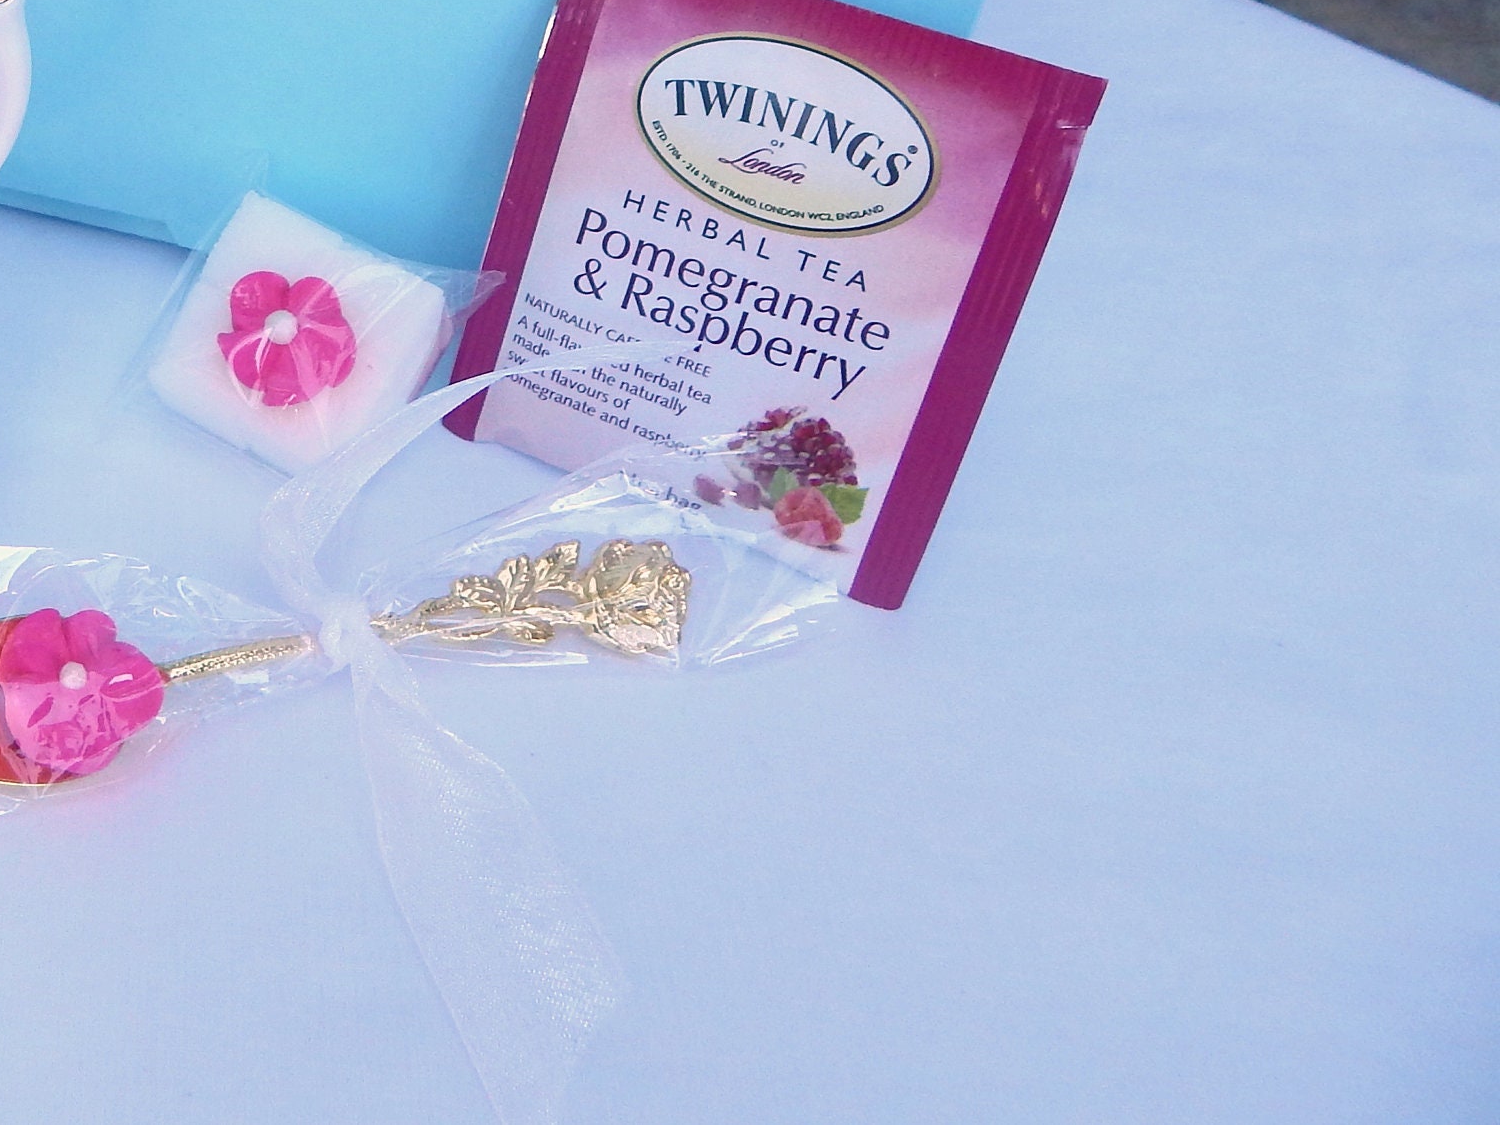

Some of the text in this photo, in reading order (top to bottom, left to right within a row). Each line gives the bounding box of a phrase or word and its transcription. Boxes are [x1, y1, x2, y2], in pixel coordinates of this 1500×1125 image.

[664, 79, 912, 188] TWININGS
[717, 147, 807, 185] London
[665, 142, 683, 161] 1706
[684, 161, 701, 177] 216
[700, 173, 719, 189] THE
[759, 202, 805, 219] LONDON
[835, 204, 885, 221] ENGLAND
[575, 207, 891, 351] Pomegranate
[622, 189, 867, 292] HERBAL TEA
[517, 315, 530, 330] A
[634, 363, 685, 394] herbal
[686, 385, 712, 405] tea
[524, 292, 712, 378] NATURALLY FREE
[573, 258, 608, 301] &
[620, 271, 867, 401] Raspberry
[504, 372, 597, 418] omegranate
[599, 411, 631, 431] and
[513, 332, 551, 357] made
[590, 365, 617, 387] the
[619, 381, 688, 417] naturally
[550, 369, 610, 404] flavours
[612, 397, 633, 411] of
